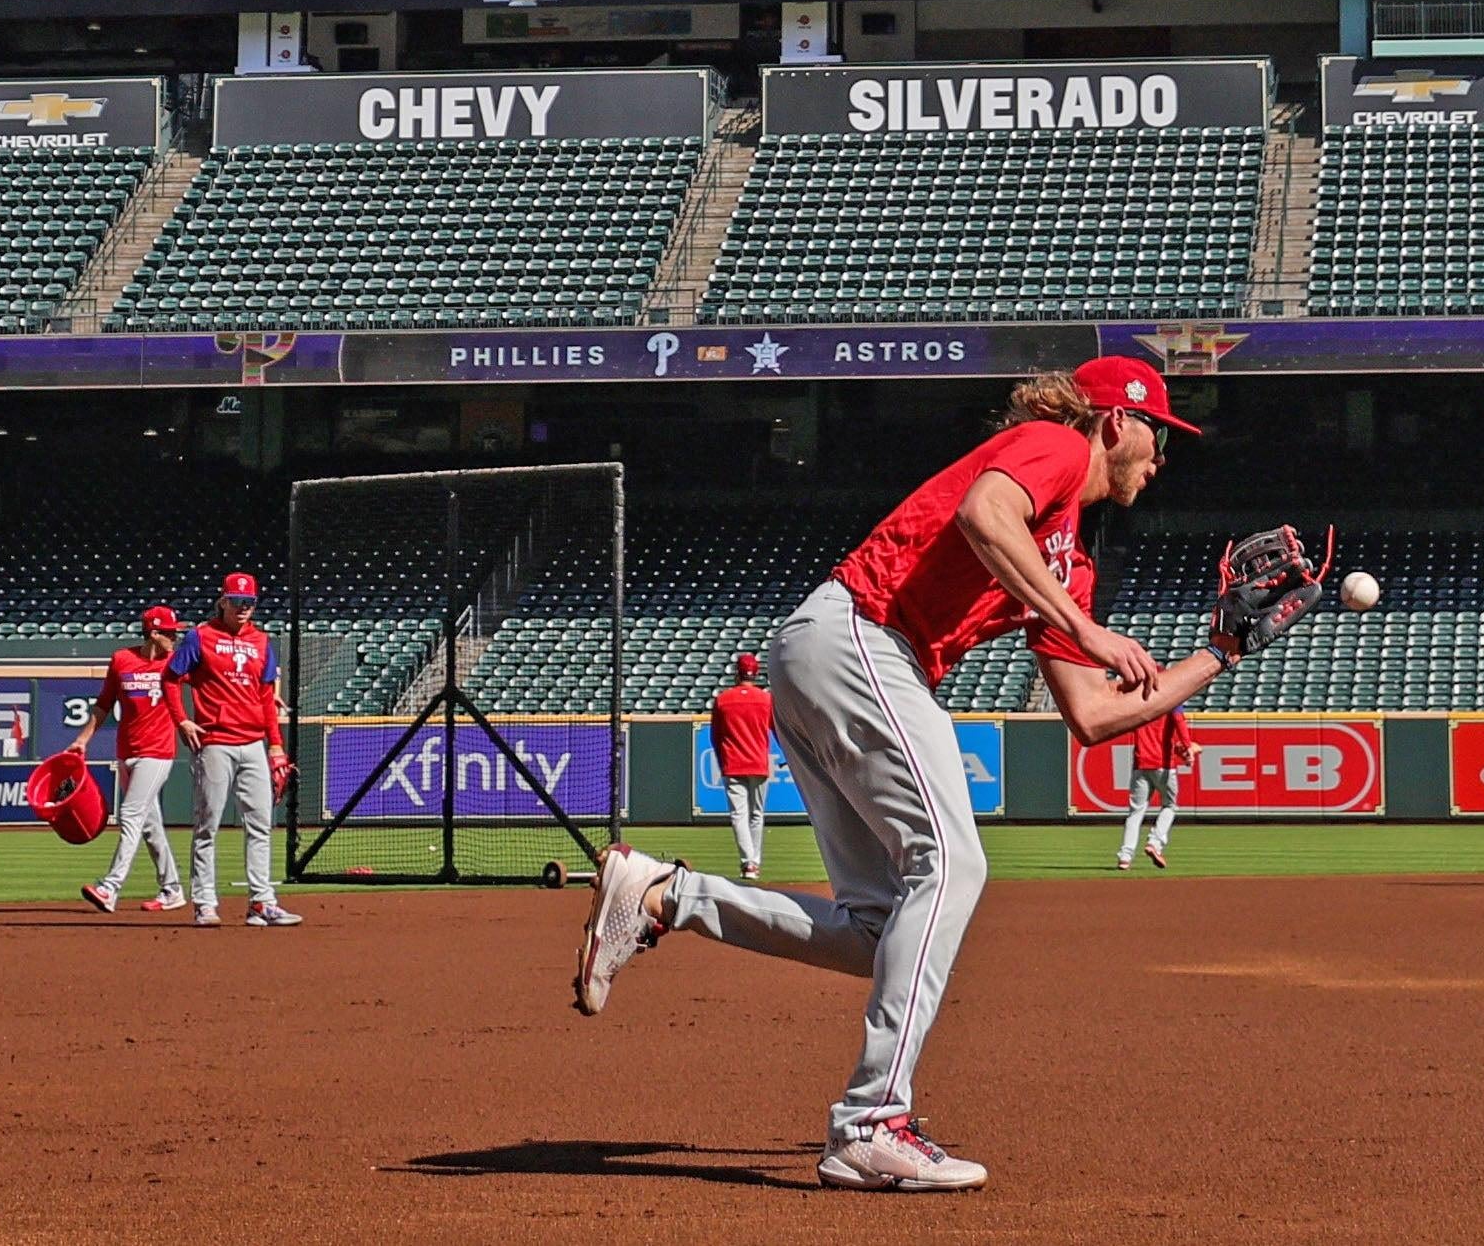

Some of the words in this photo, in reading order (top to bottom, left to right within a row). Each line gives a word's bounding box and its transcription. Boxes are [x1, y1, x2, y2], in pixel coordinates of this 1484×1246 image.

[358, 86, 561, 139] CHEVY
[848, 75, 1179, 132] SILVERADO
[1352, 110, 1478, 126] CHEVROLET
[450, 345, 605, 367] PHILLIES
[646, 332, 680, 376] P
[834, 342, 966, 362] ASTROS
[215, 644, 259, 659] PHILLIES
[379, 736, 573, 808] xfnity
